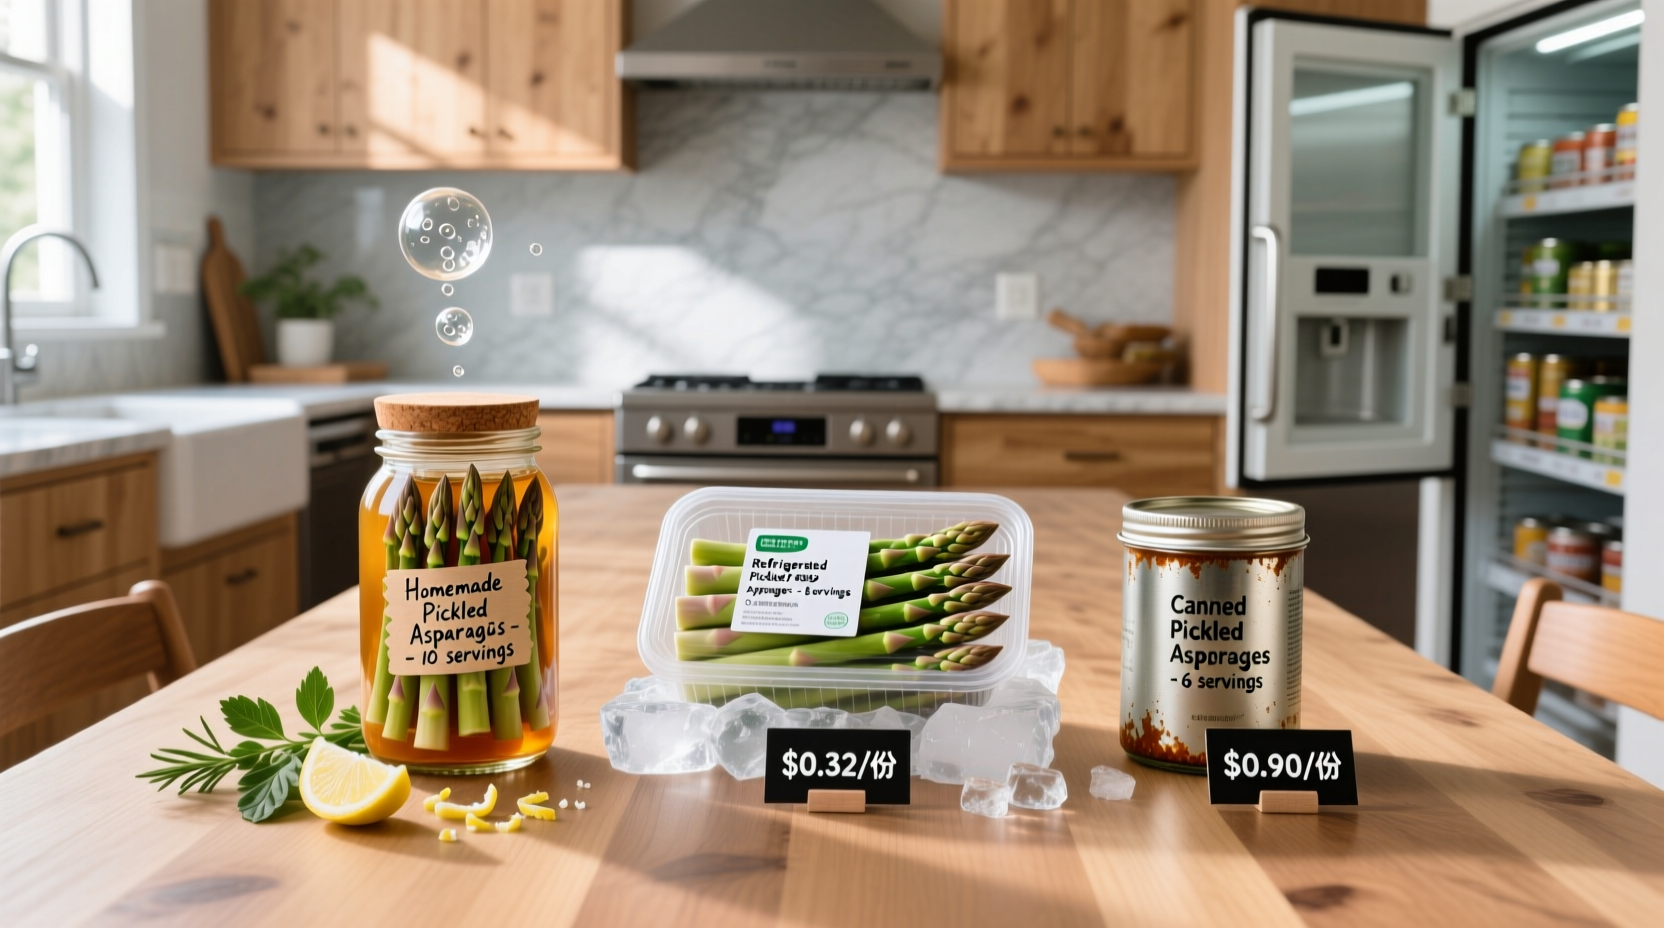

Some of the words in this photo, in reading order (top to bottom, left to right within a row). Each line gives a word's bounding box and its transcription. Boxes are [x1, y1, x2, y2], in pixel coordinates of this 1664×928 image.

[405, 572, 503, 601] Homemade
[423, 597, 488, 624] Pickled
[1171, 594, 1247, 616] Canned
[1170, 619, 1244, 641] Pickled
[422, 649, 438, 666] 10
[446, 642, 515, 665] servings
[1181, 672, 1192, 689] 6
[1197, 673, 1263, 694] servings
[782, 748, 897, 780] $0.32/份
[1223, 748, 1342, 781] $0.90/份
